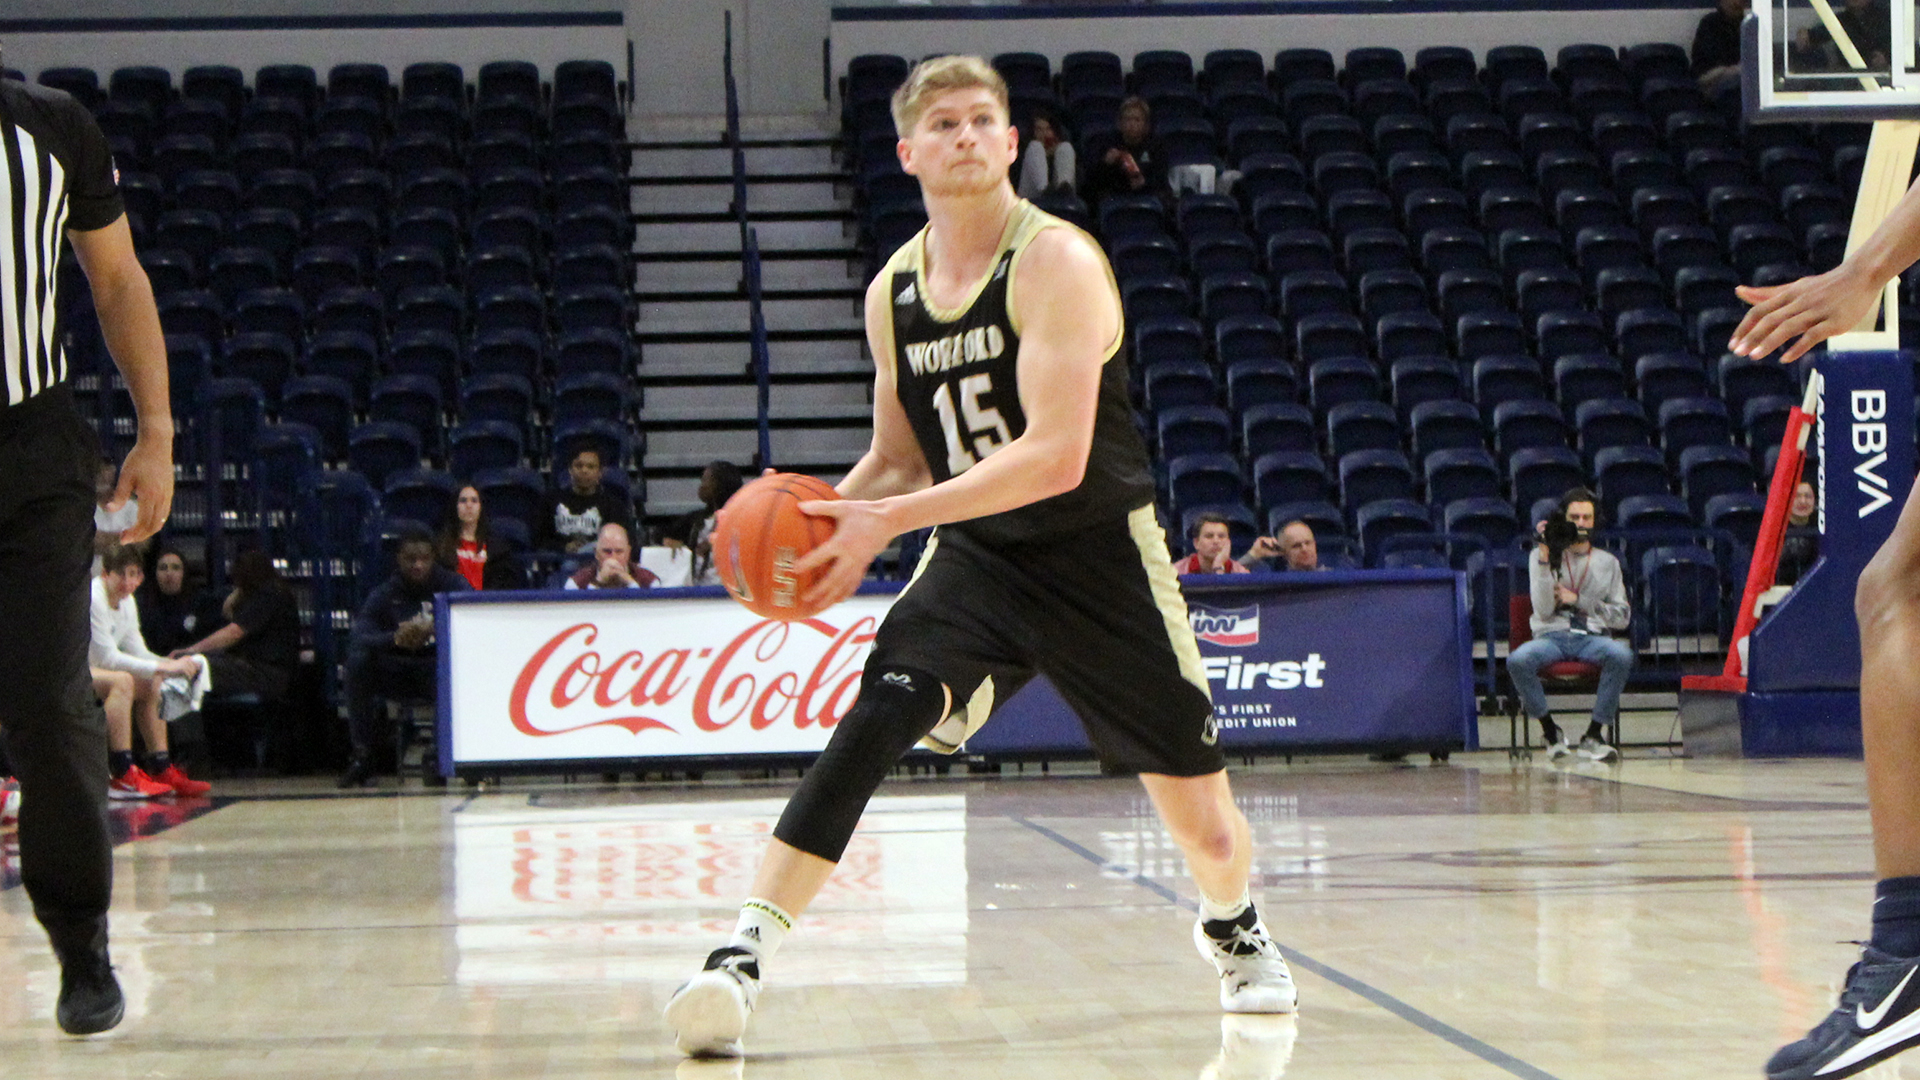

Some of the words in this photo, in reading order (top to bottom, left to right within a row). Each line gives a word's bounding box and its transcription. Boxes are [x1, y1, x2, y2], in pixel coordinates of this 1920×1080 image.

[933, 373, 1013, 476] 15
[1817, 372, 1826, 535] SAMFORD
[1851, 390, 1893, 519] BBVA
[1217, 718, 1247, 729] EDIT
[1253, 717, 1297, 728] UNION
[1232, 704, 1272, 715] FIRST
